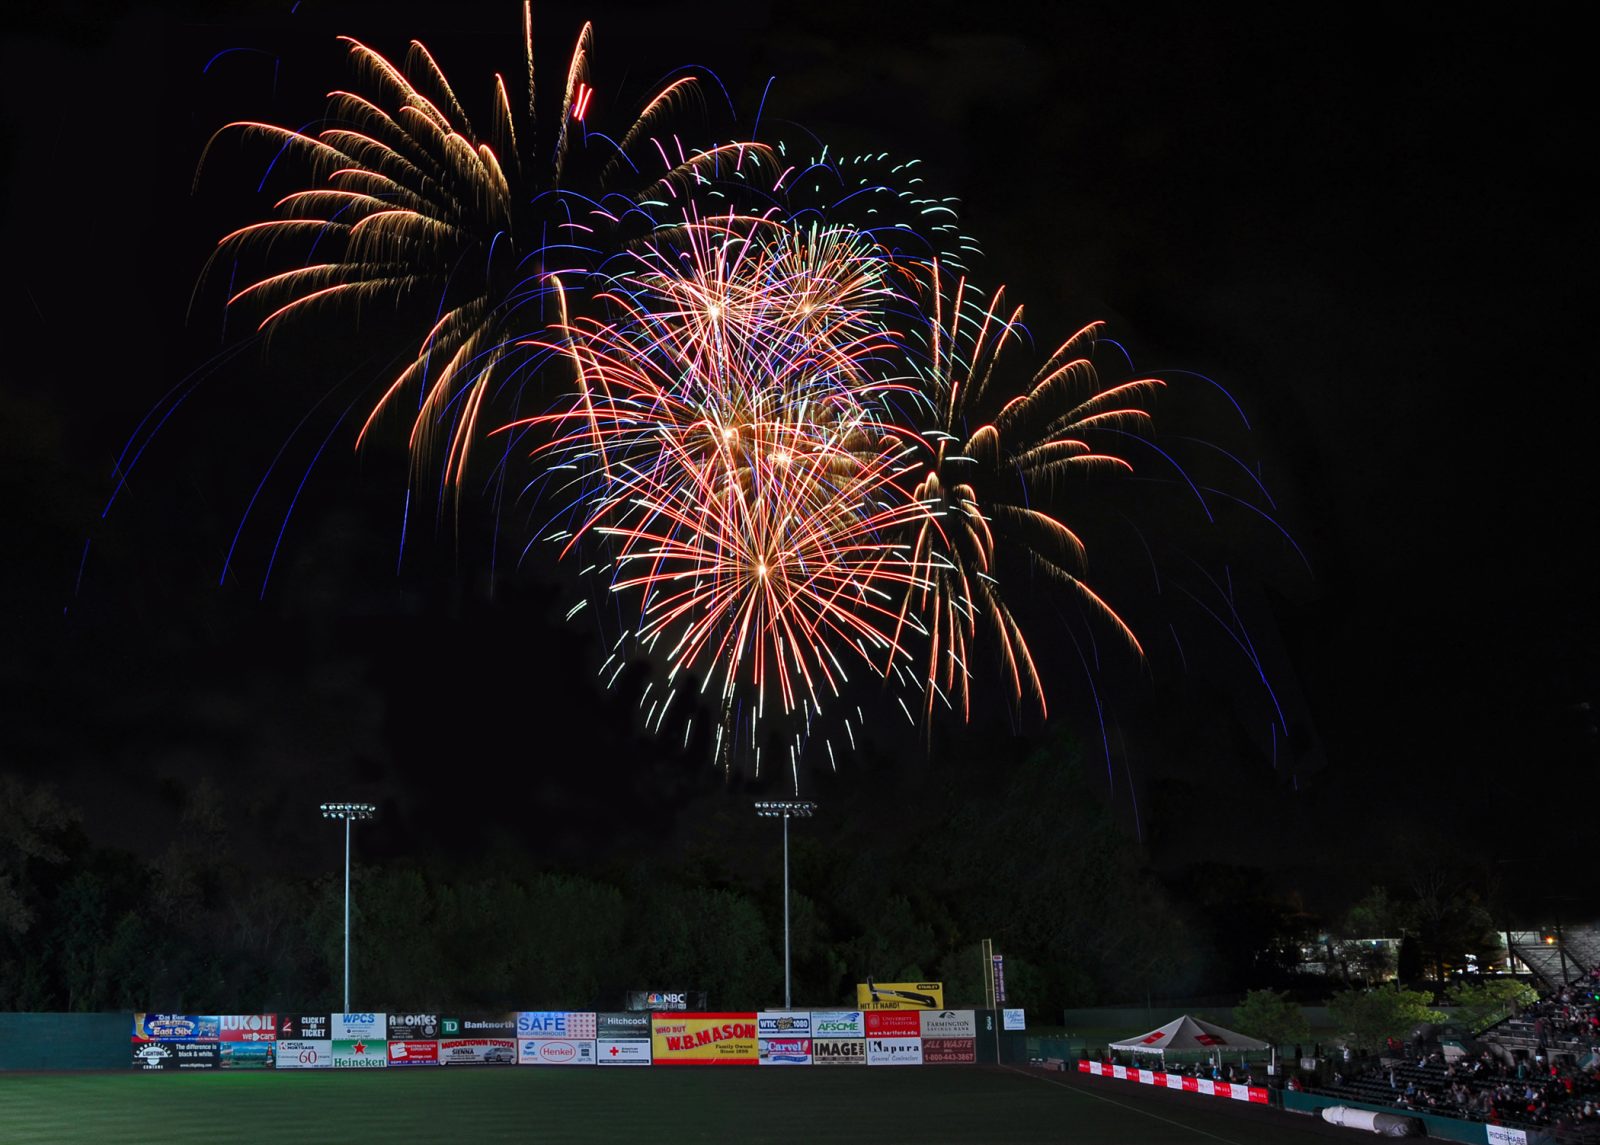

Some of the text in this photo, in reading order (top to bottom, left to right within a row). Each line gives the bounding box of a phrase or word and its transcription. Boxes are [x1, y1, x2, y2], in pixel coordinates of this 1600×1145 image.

[663, 994, 685, 1003] NBC
[221, 1016, 274, 1030] LUKOIL
[343, 1014, 375, 1023] WPCS
[389, 1014, 437, 1026] ROOKIES
[443, 1022, 457, 1031] TD
[519, 1018, 565, 1030] SAFE
[302, 1029, 325, 1037] TICKET
[442, 1040, 514, 1049] MIDDLETOWN TOYOTA
[768, 1042, 801, 1051] Carvel
[869, 1041, 919, 1052] Kapura
[944, 1040, 972, 1048] WASTE
[814, 1043, 858, 1055] IMAGE
[299, 1050, 317, 1064] 60
[334, 1058, 384, 1067] Heineken
[1489, 1131, 1525, 1143] RIDESHARE
